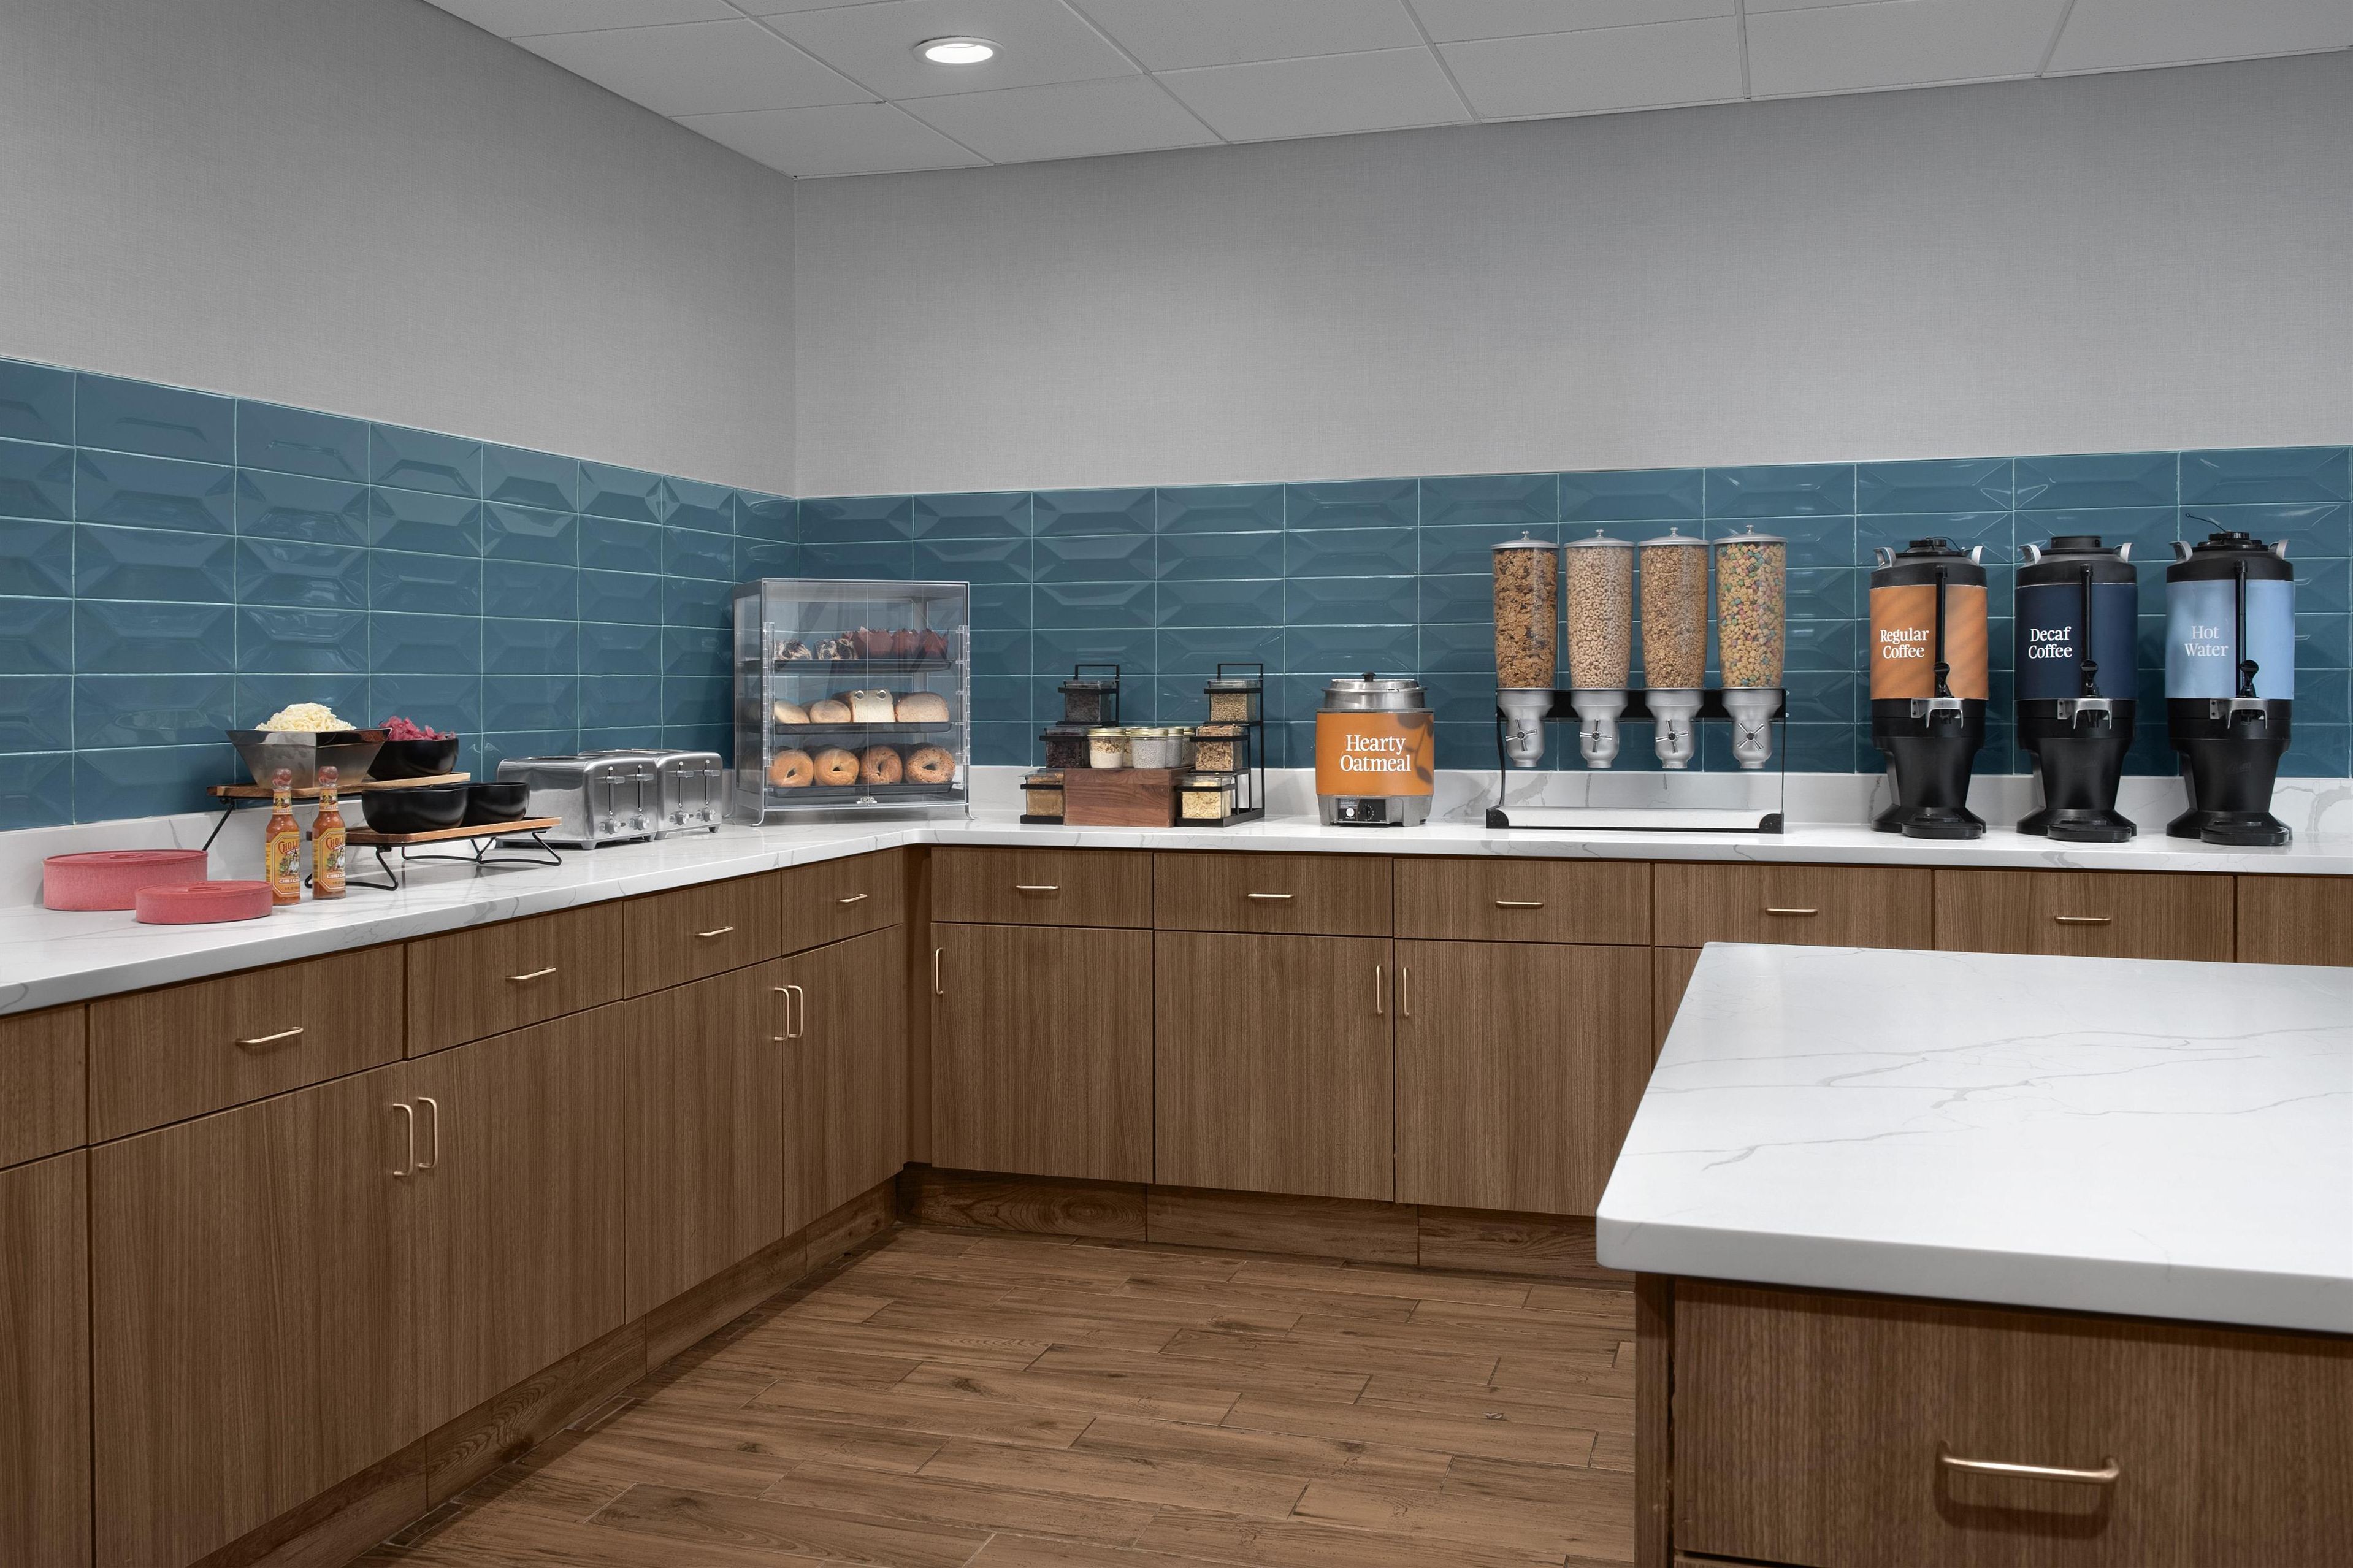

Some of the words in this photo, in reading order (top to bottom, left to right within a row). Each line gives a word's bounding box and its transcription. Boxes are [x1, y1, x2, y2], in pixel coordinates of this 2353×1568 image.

[1880, 627, 1929, 645] Regular
[2030, 626, 2072, 642] Decaf
[2190, 625, 2220, 639] Hot
[1883, 644, 1924, 659] Coffee
[2028, 643, 2073, 659] Coffee
[2184, 643, 2229, 657] Water
[1345, 735, 1406, 755] Hearty
[1340, 754, 1411, 771] Oatmeal
